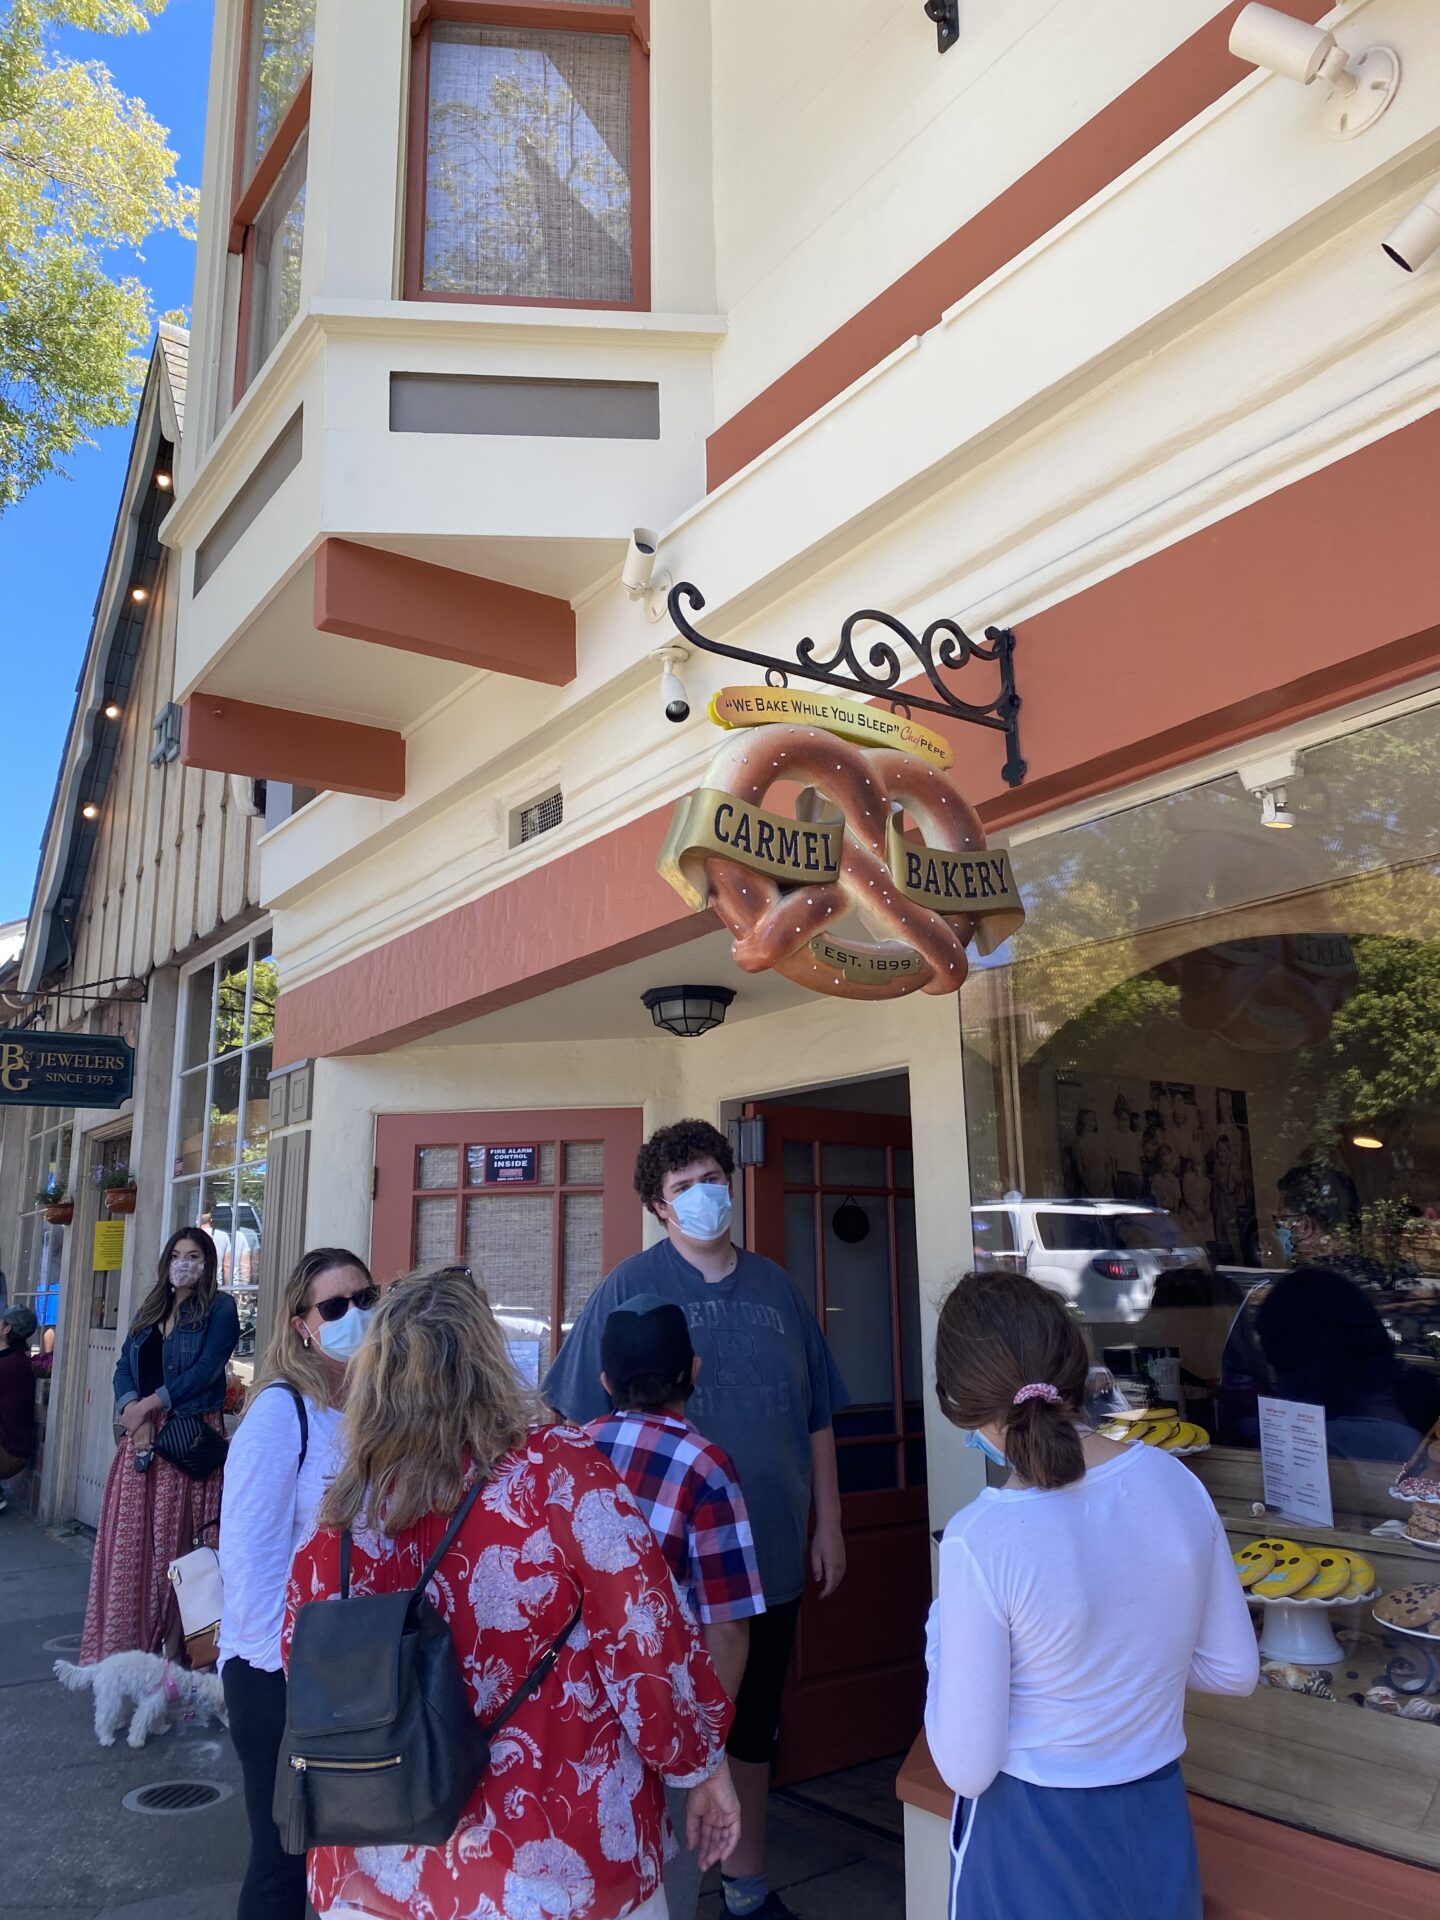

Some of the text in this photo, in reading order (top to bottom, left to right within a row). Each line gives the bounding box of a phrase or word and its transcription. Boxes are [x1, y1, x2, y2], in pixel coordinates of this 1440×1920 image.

[757, 698, 789, 713] BAKE
[791, 700, 829, 719] WHILE
[831, 706, 854, 725] YOU
[899, 726, 923, 750] Chef
[714, 803, 838, 872] CARMEL
[905, 851, 1010, 901] BAKERY
[824, 946, 911, 971] EST. 1899
[36, 1052, 125, 1070] JEWELERS
[46, 1072, 114, 1085] SINCE 1973
[681, 1299, 785, 1335] EDWOOD
